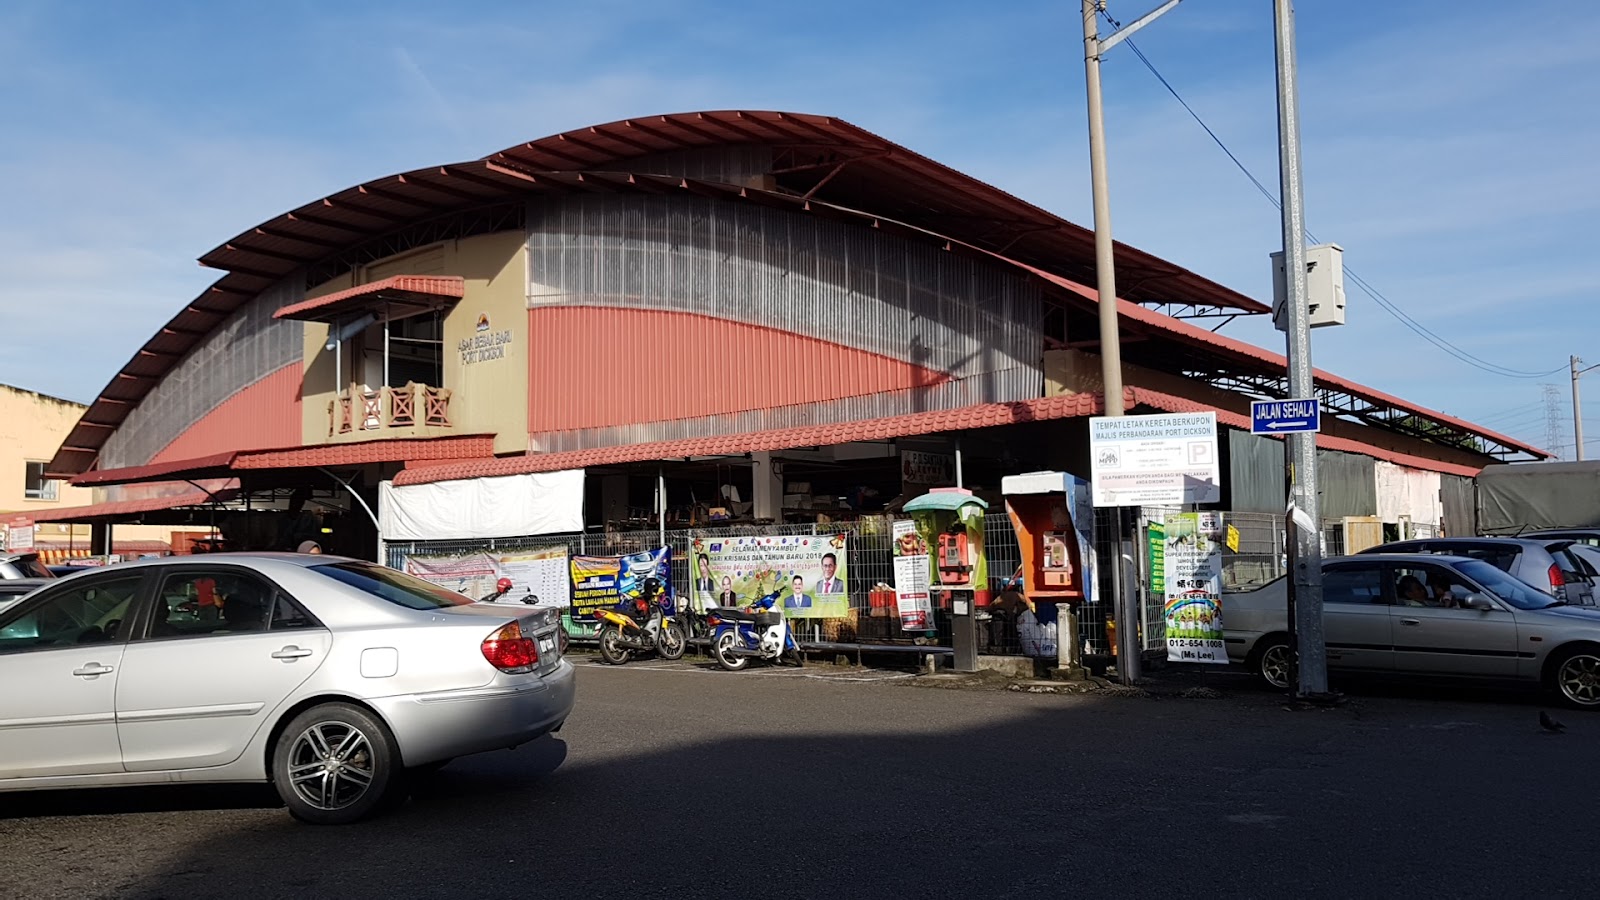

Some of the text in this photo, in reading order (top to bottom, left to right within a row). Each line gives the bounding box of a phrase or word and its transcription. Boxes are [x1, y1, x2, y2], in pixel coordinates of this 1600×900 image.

[474, 334, 494, 349] BESAR
[496, 329, 512, 344] BARU
[462, 345, 505, 365] PORT DICKSON
[1256, 401, 1315, 420] JALAN SEHALA
[1096, 416, 1210, 430] TEMPAT LETAK KERETA BERKUPON
[1096, 427, 1212, 440] MAJLIS PERBANDARAN PORT DICKSON
[1192, 444, 1206, 462] P
[731, 543, 799, 553] SELAMAT MENYAMBUT
[724, 554, 750, 562] KRISMAS
[806, 552, 822, 560] 2018
[1169, 639, 1203, 647] 012-654
[1181, 650, 1215, 660] (Ms Lee)
